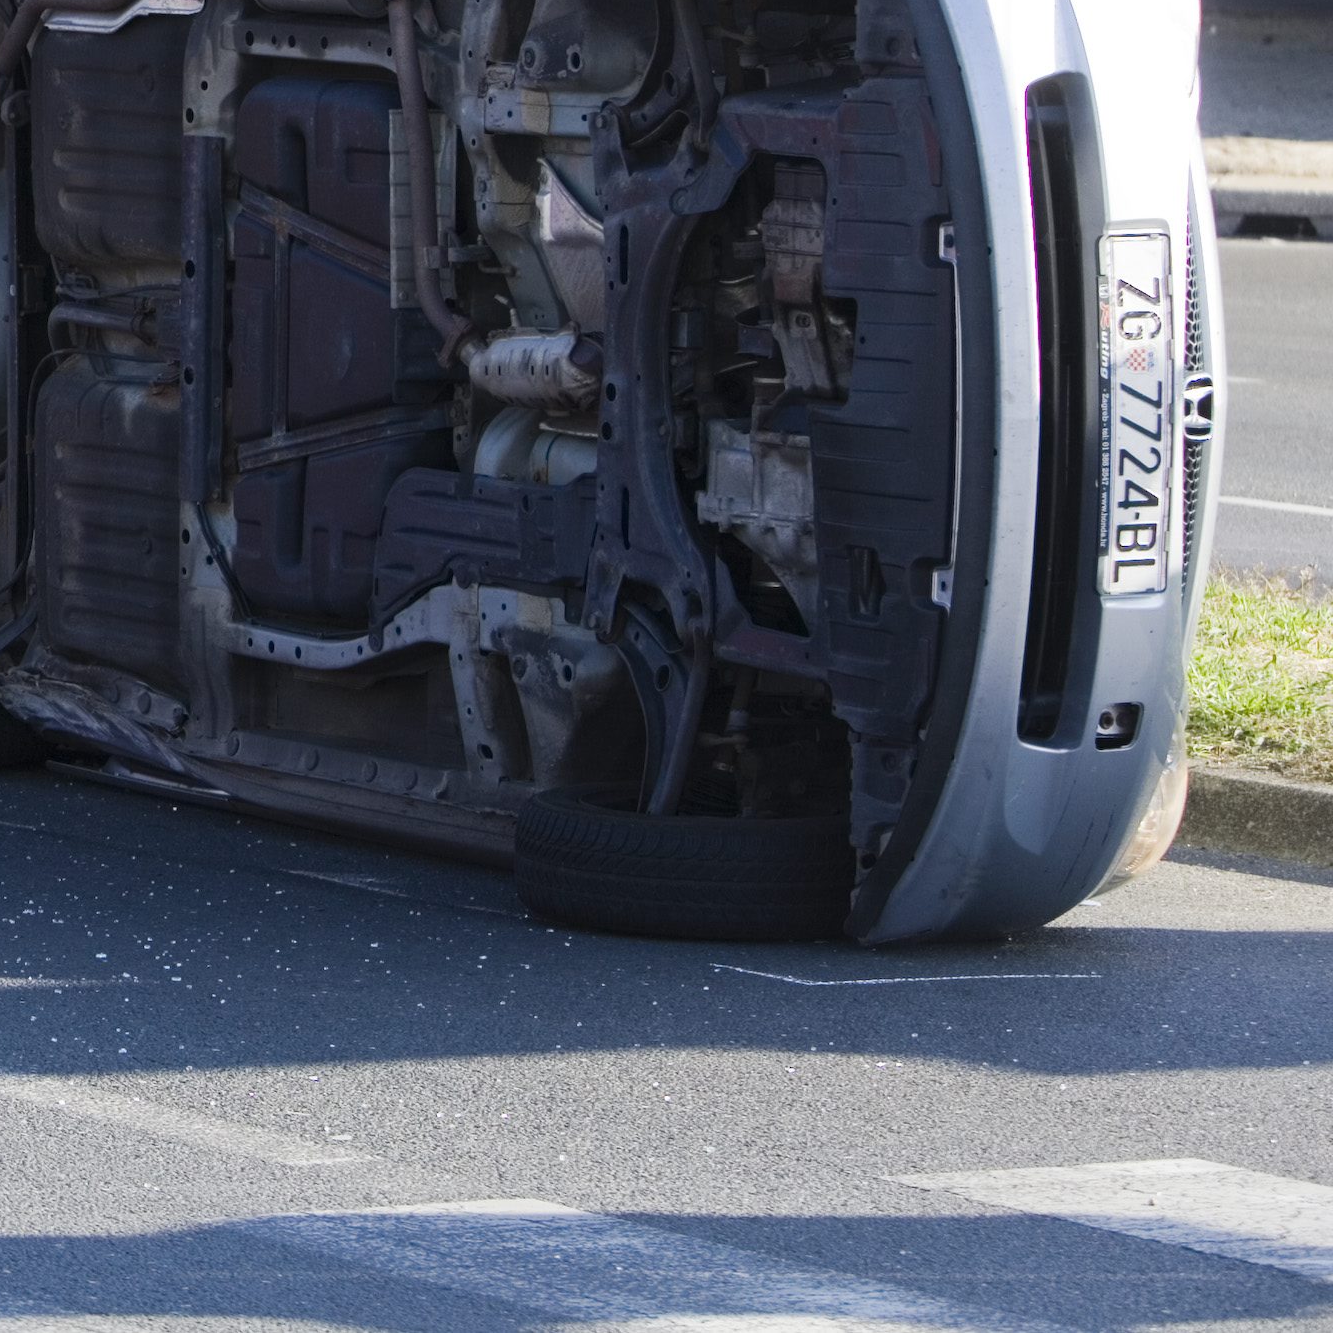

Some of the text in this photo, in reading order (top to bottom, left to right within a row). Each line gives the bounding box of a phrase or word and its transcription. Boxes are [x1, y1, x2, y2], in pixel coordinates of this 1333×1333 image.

[1101, 393, 1109, 421] Zagreb
[1113, 276, 1162, 583] ZG 7724-BL
[1102, 441, 1109, 450] 01
